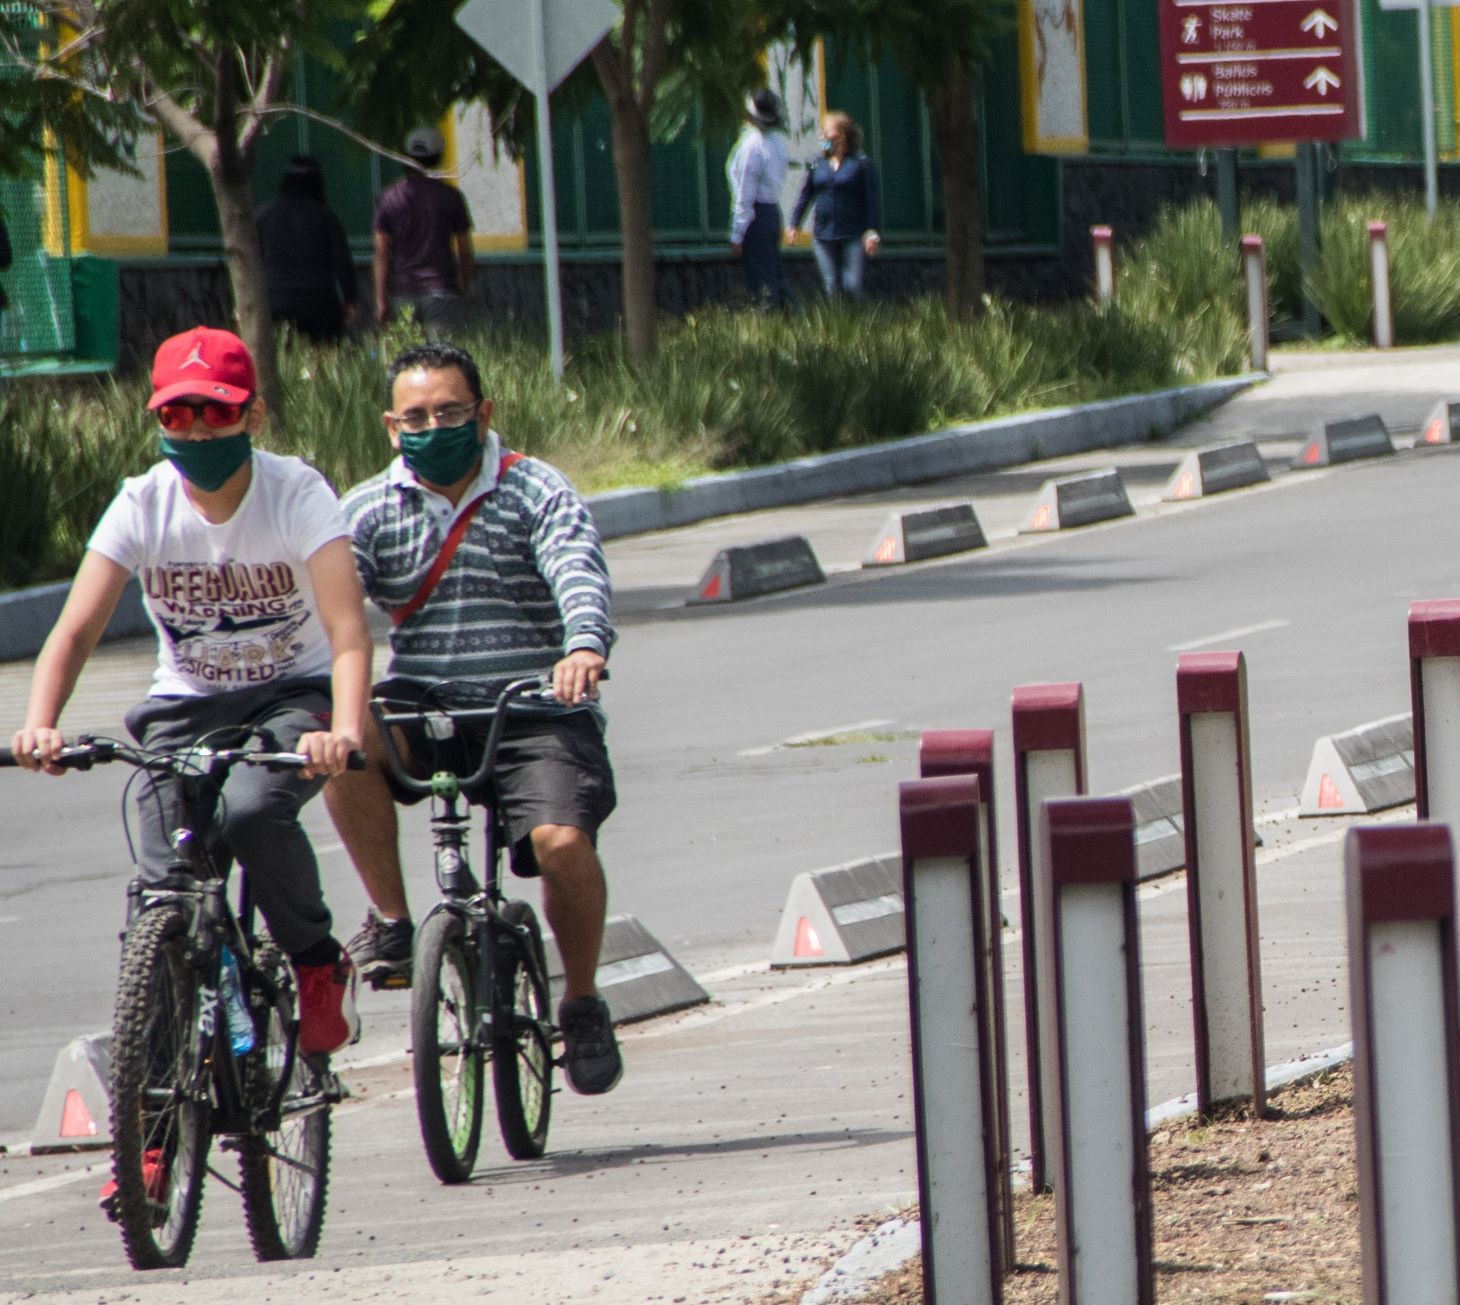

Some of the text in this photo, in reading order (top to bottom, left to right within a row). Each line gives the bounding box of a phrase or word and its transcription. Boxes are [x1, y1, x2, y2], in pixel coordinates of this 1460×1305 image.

[1211, 8, 1253, 22] Skate
[1210, 24, 1245, 40] Park
[145, 562, 295, 601] LIFEGUARD
[162, 598, 286, 618] WARNING
